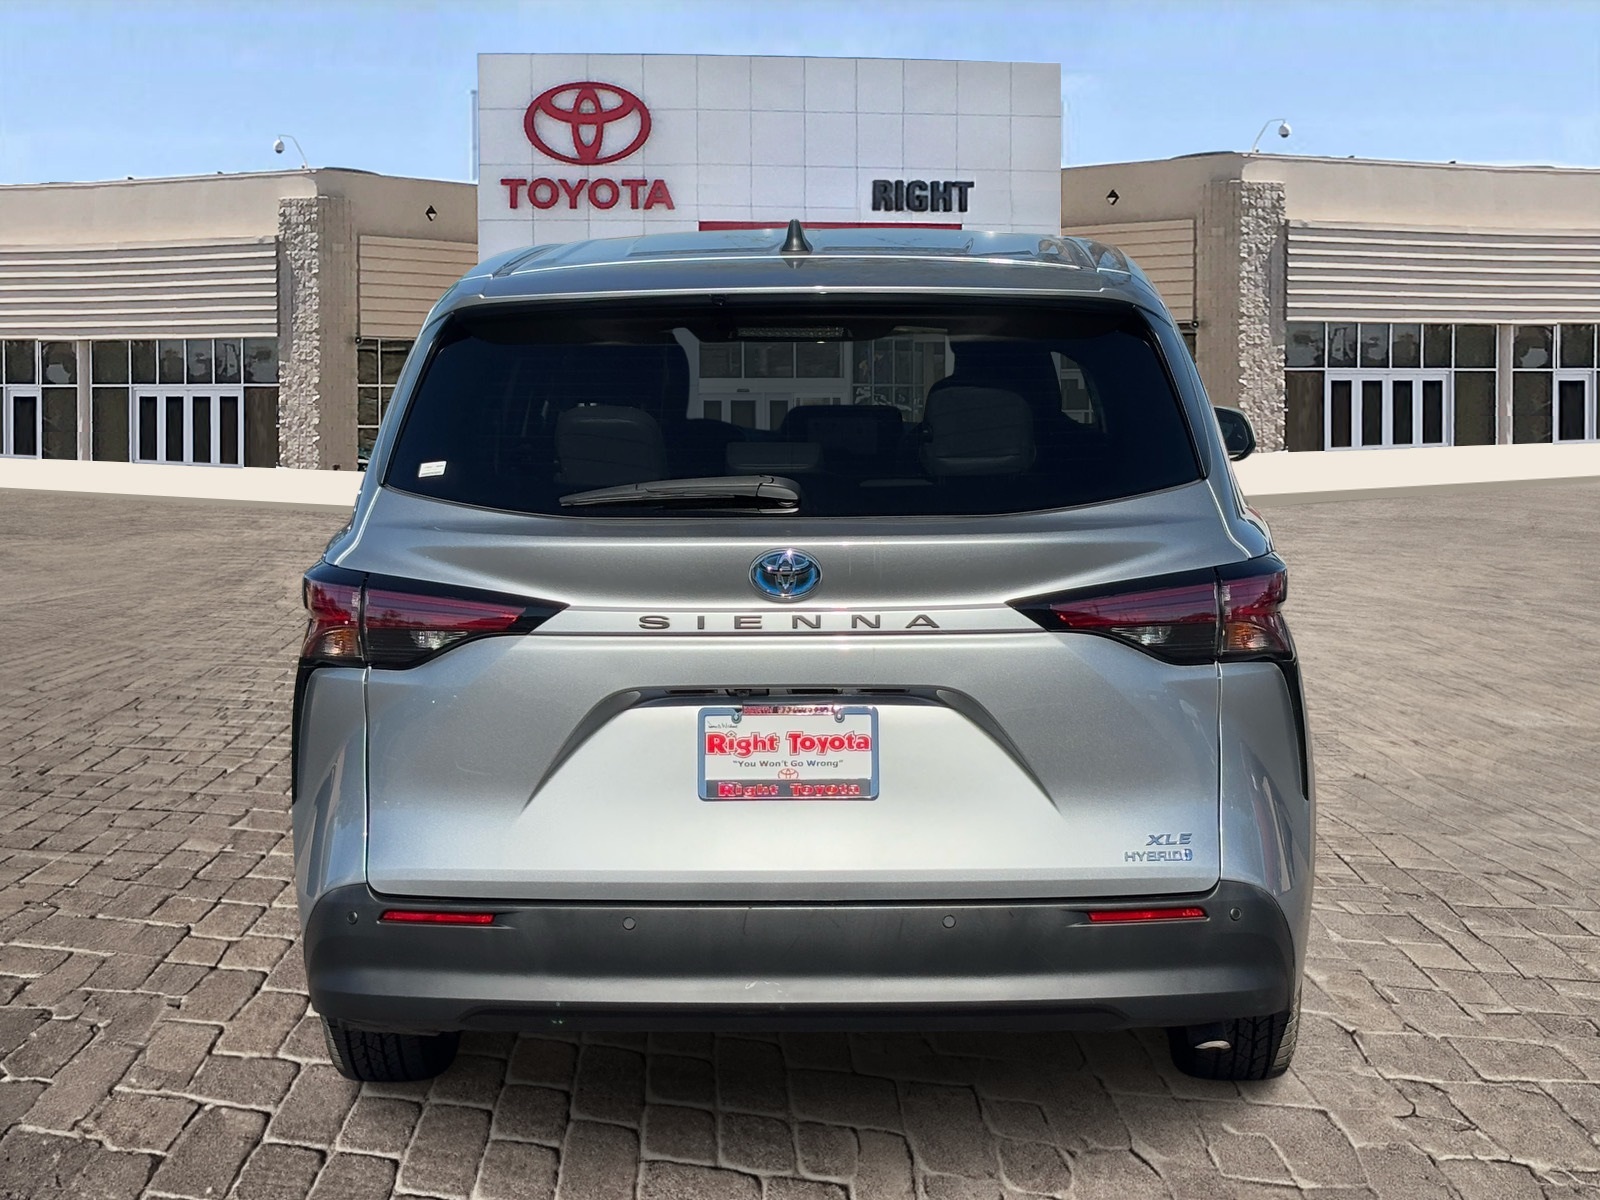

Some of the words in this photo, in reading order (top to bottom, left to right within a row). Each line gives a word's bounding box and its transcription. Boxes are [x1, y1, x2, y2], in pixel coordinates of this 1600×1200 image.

[500, 179, 675, 210] TOYOTA
[872, 179, 975, 213] RIGHT
[638, 614, 940, 630] SIENNA
[705, 731, 780, 757] Right
[785, 731, 873, 756] Toyota
[759, 760, 788, 768] Won't
[790, 760, 804, 768] Go
[717, 782, 778, 797] Right
[790, 783, 860, 796] Toyota
[1145, 833, 1193, 846] XLE
[1124, 850, 1183, 862] HYBRID
